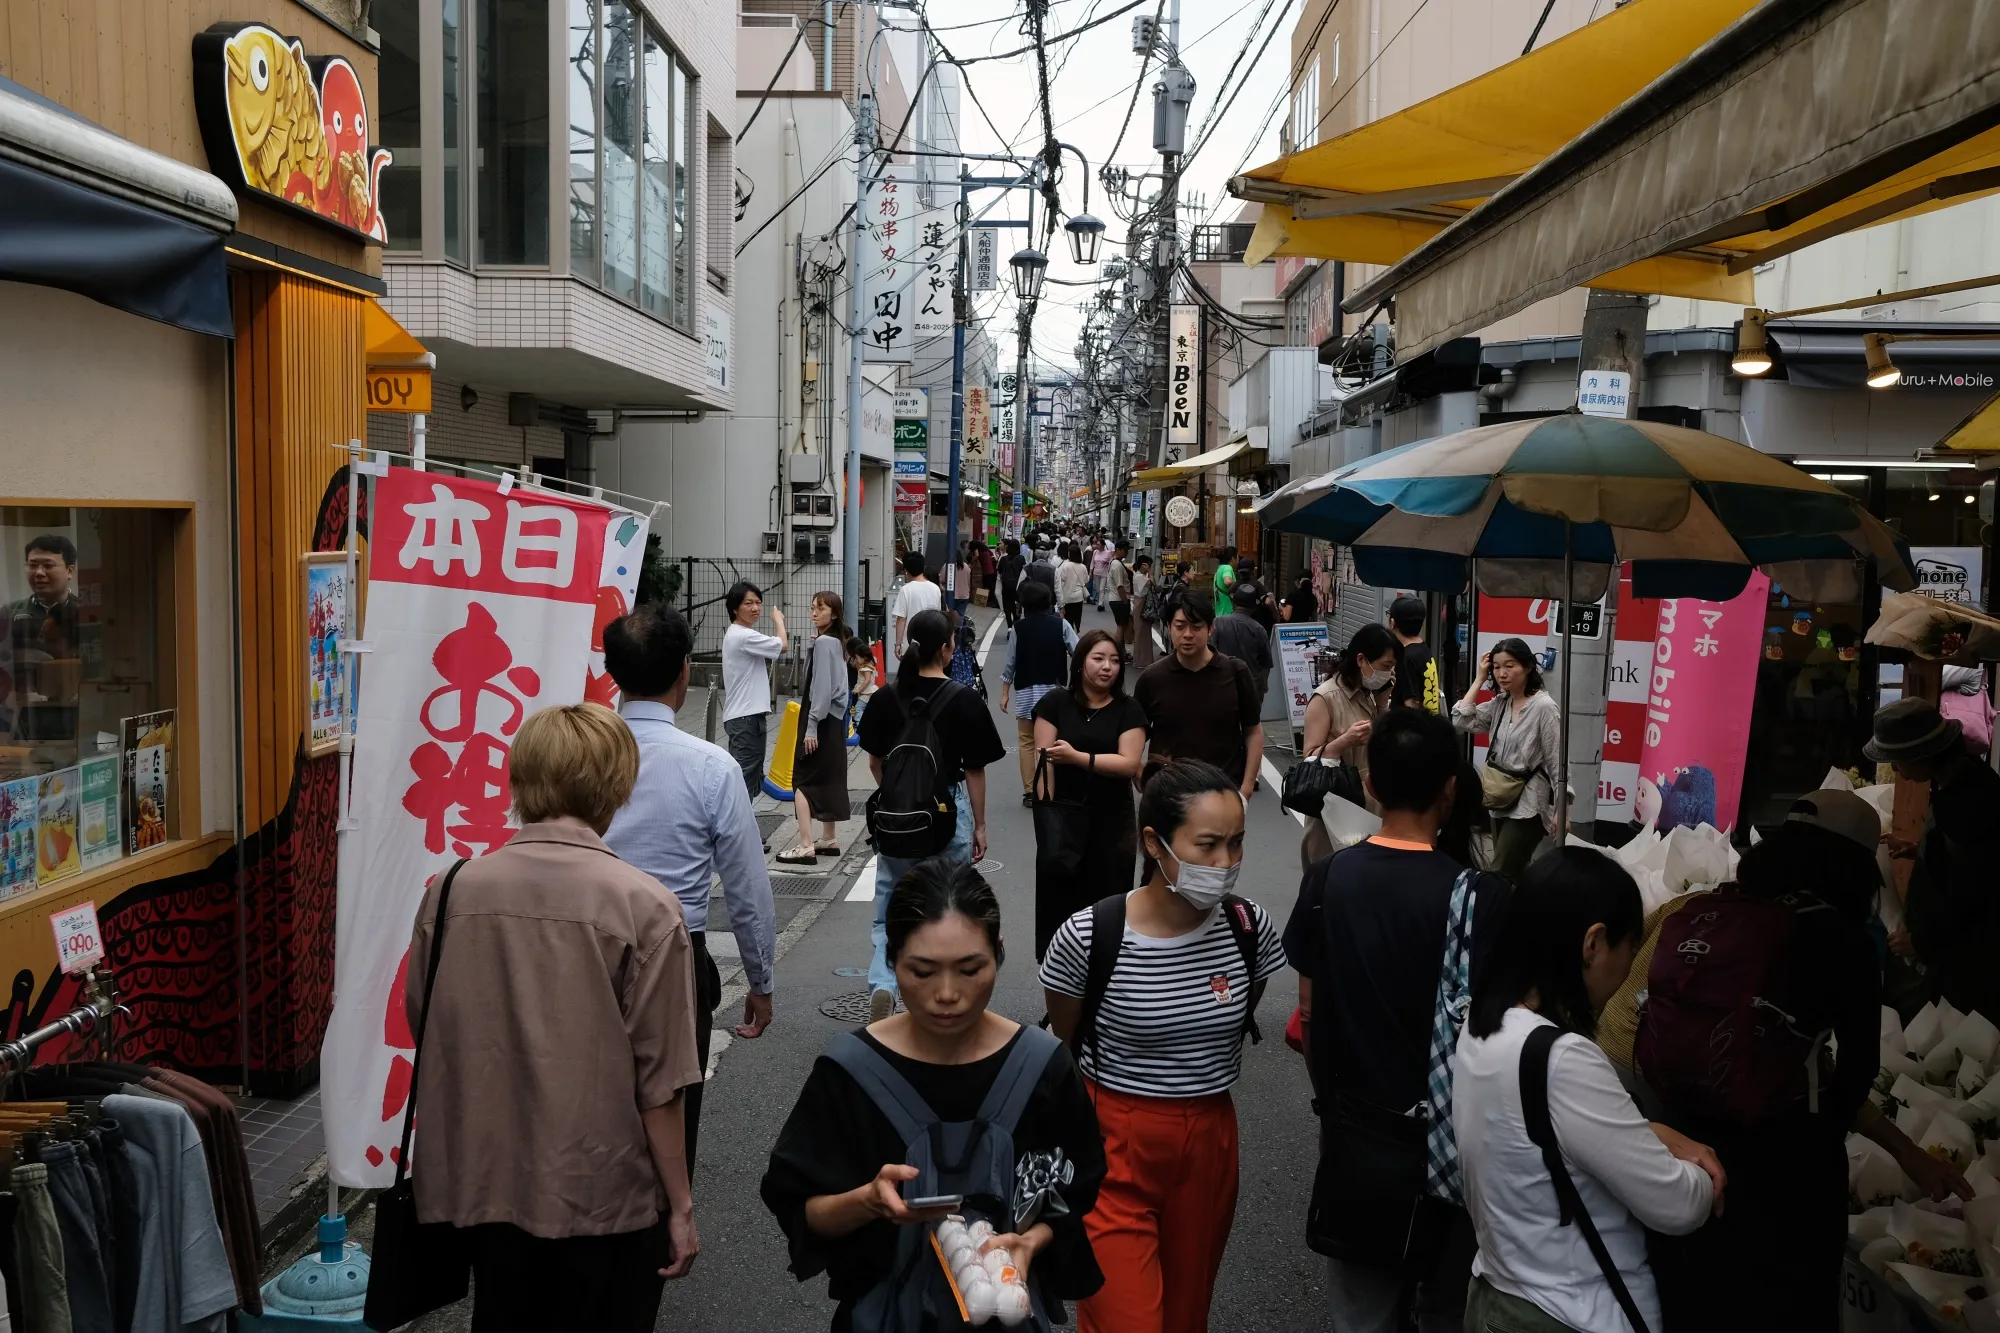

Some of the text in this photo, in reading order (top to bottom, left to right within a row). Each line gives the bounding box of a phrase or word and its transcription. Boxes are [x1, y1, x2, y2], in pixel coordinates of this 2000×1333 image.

[977, 231, 991, 288] 大船仲通商店会
[872, 290, 902, 353] 田中
[1171, 335, 1191, 429] 東京 BeeN
[1581, 393, 1626, 406] 糖尿病内科
[1938, 372, 1994, 387] Mobile
[398, 483, 578, 588] 本日
[1693, 600, 1723, 657] マホ
